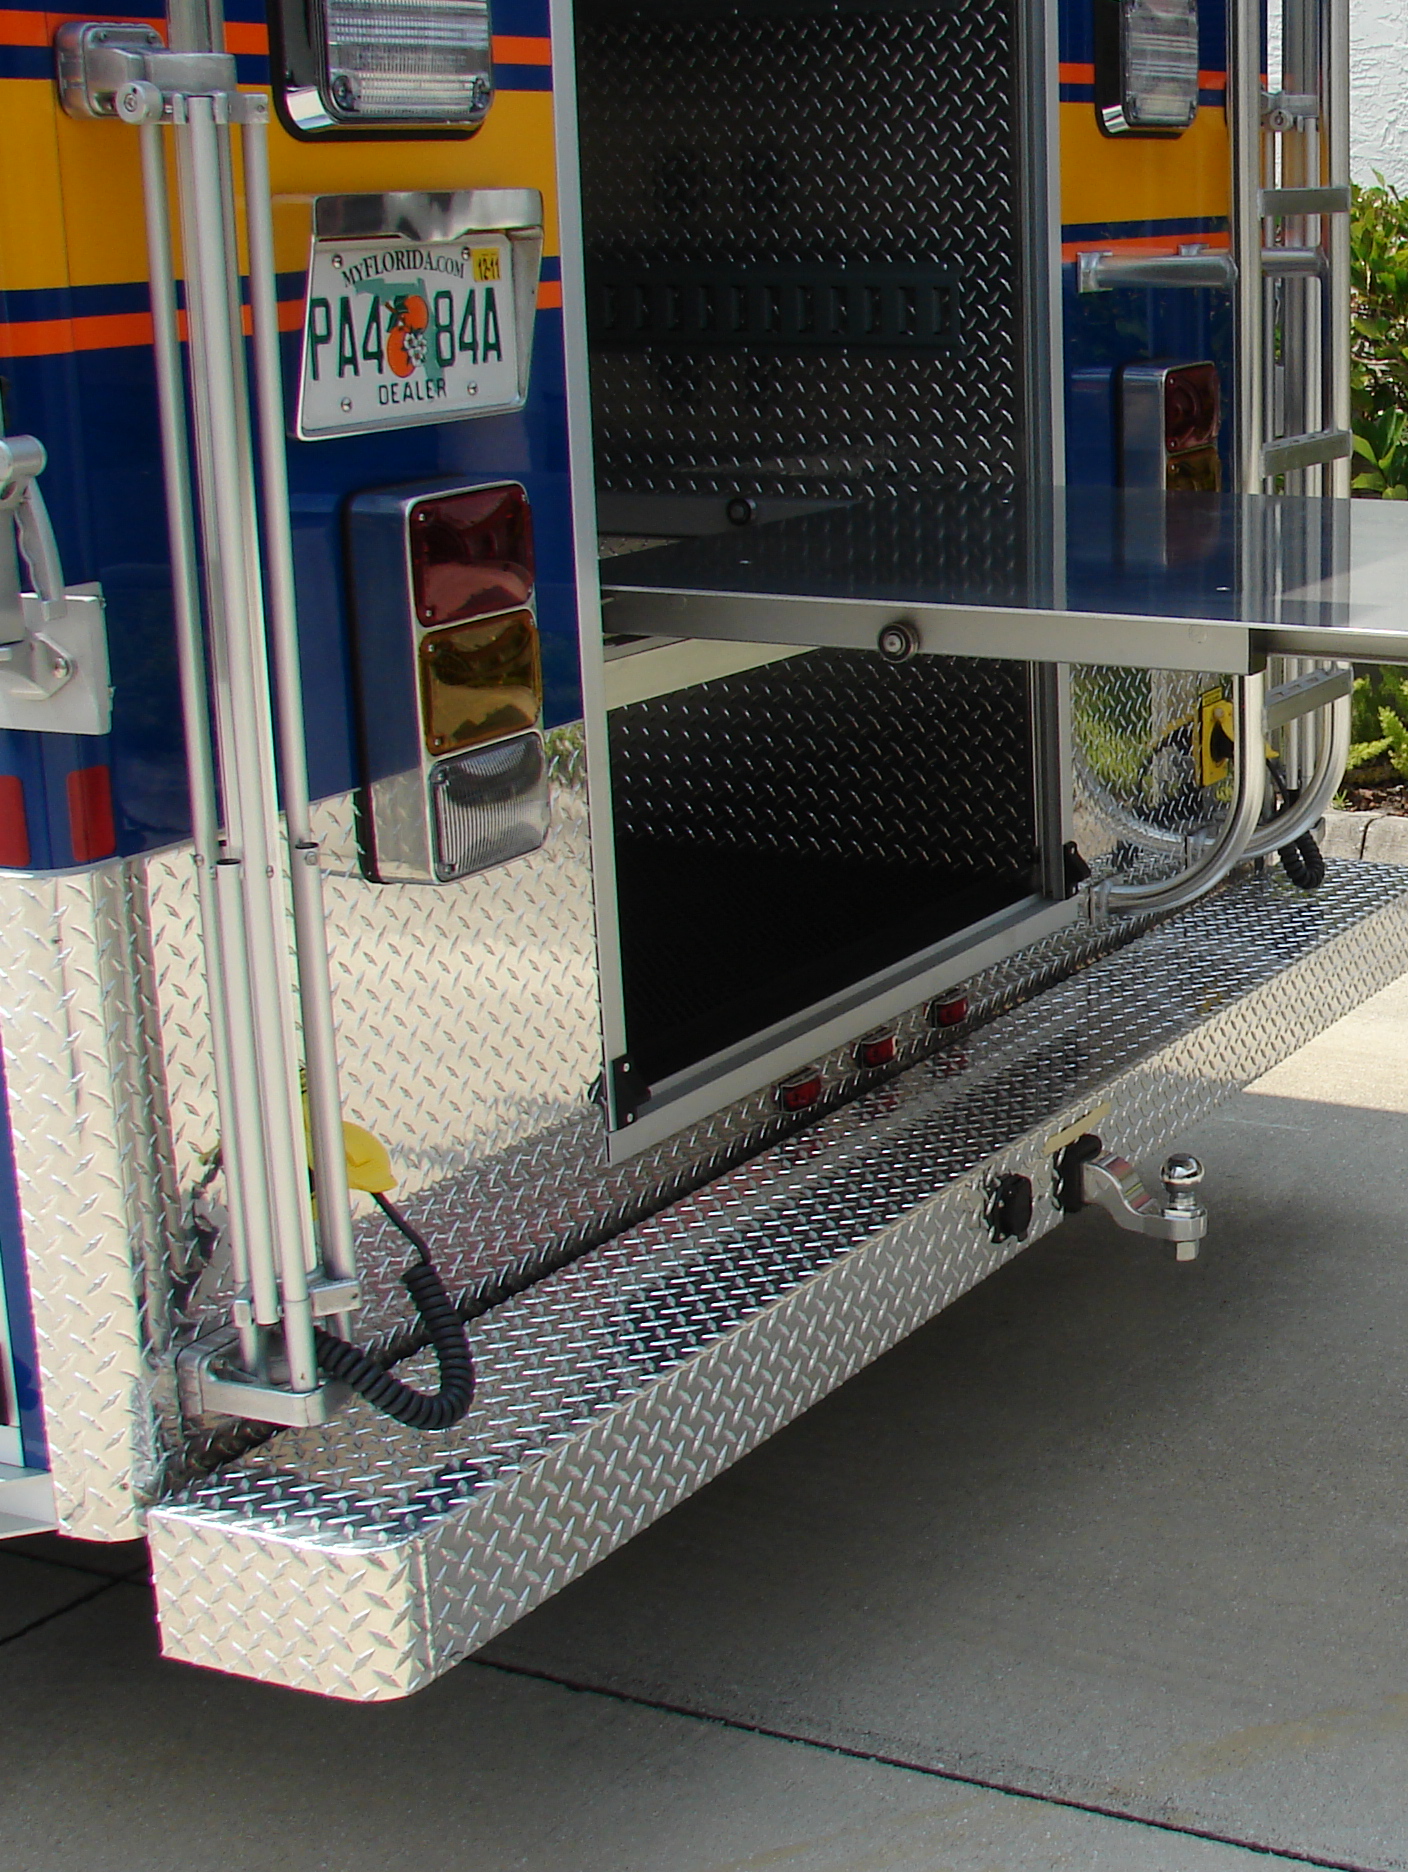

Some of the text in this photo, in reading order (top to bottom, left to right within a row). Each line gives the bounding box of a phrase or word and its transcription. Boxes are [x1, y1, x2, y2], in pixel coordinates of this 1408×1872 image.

[309, 287, 503, 381] PA4 84A
[378, 379, 447, 406] DEALER
